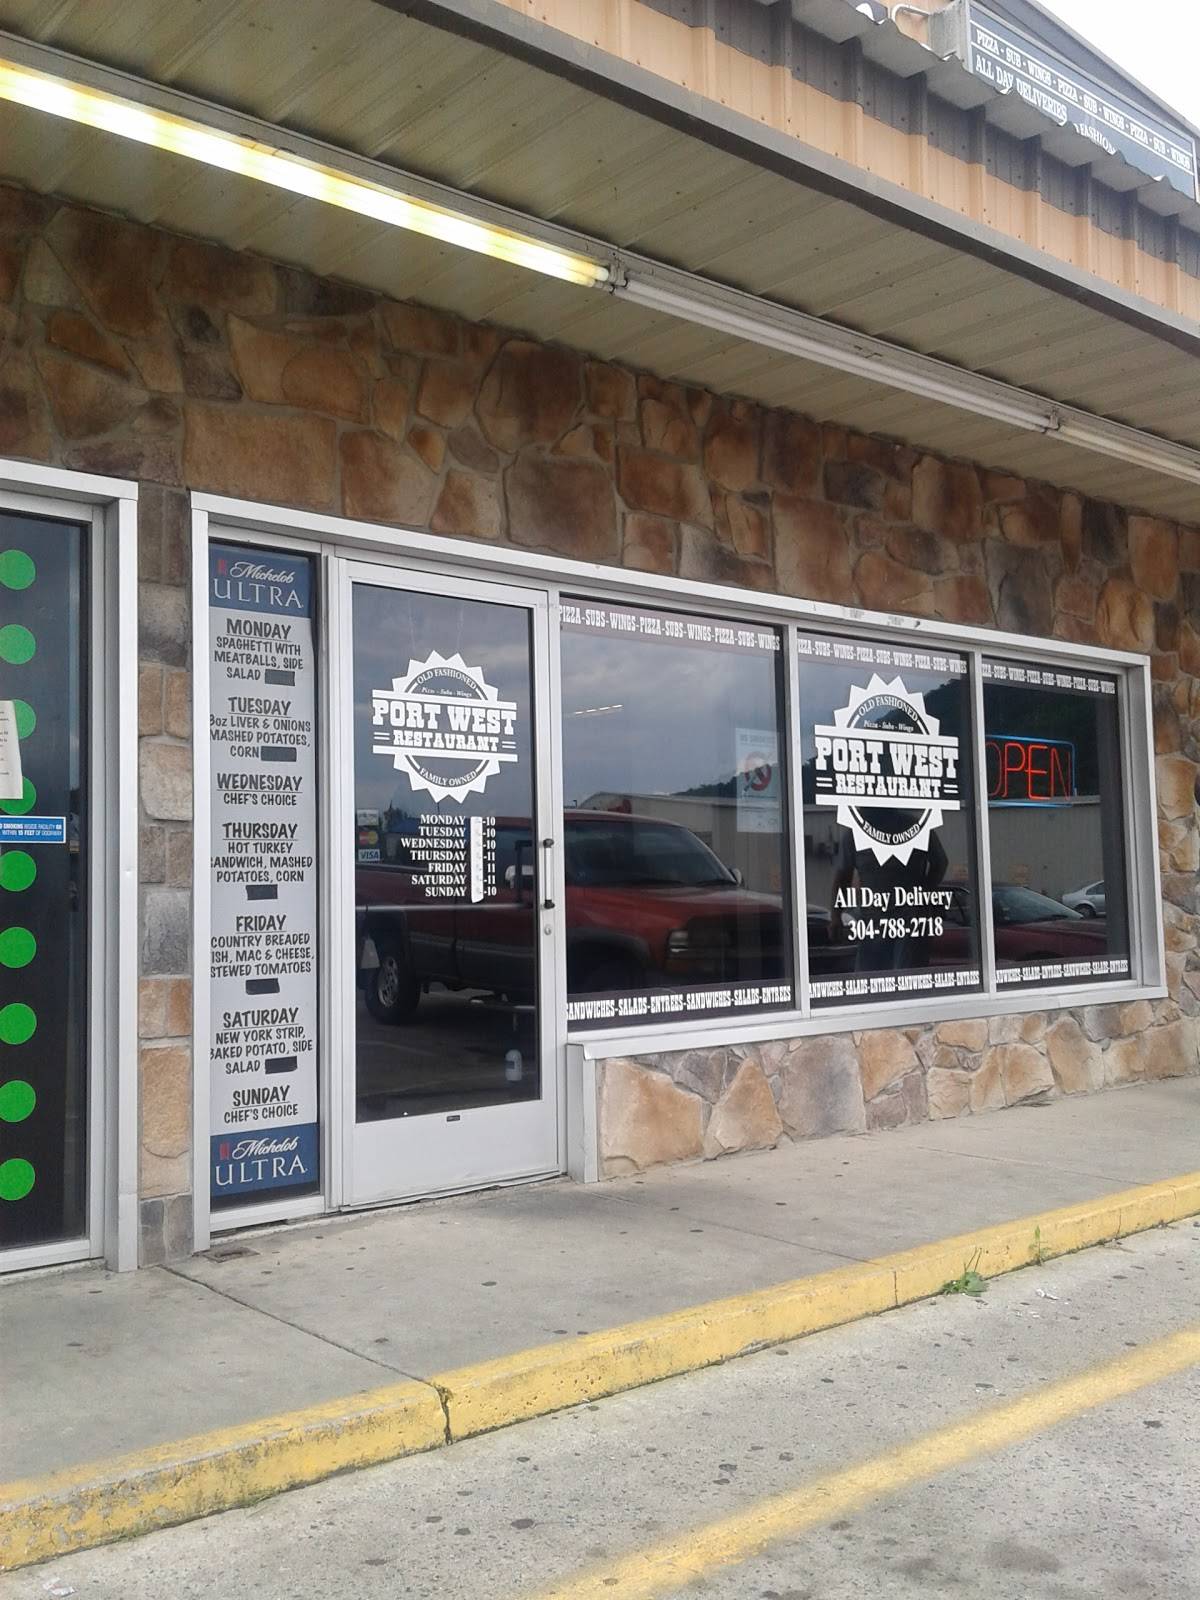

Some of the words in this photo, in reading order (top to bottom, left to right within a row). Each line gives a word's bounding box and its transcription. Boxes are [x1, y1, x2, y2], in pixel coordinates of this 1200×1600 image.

[976, 29, 999, 55] PIZZA
[1006, 47, 1021, 68] SUB
[1028, 61, 1051, 86] WINGS
[1058, 78, 1078, 102] PIZZA
[1083, 94, 1097, 114] SUB
[1103, 106, 1124, 130] WINGS
[1130, 122, 1148, 144] PIZZA
[976, 56, 994, 81] ALL
[996, 66, 1013, 91] DAY
[1016, 78, 1067, 124] DELIVERIES
[230, 561, 295, 583] Michelob
[214, 578, 303, 608] ULTRA
[226, 618, 291, 640] MONDAY
[216, 636, 272, 653] SPAGHETTI
[275, 642, 301, 656] WITH
[214, 650, 280, 669] MEATBALLS,
[283, 657, 304, 670] SIDE
[226, 667, 261, 681] SALAD
[416, 671, 434, 685] OLD
[434, 668, 477, 690] FASHIONED
[228, 697, 291, 715] TUESDAY
[858, 698, 875, 716] OLD
[875, 695, 919, 722] FASHIONED
[231, 716, 259, 729] LIVER
[263, 718, 270, 729] &
[273, 719, 311, 732] ONIONS
[372, 699, 441, 730] PORT
[447, 705, 517, 735] WEST
[210, 729, 253, 743] MASHED
[257, 732, 311, 747] POTATOES,
[393, 730, 499, 751] RESTAURANT
[230, 745, 259, 758] CORN
[815, 736, 883, 774] PORT
[889, 742, 959, 778] WEST
[217, 773, 302, 791] WEDNESDAY
[419, 769, 447, 786] FAMILY
[448, 770, 477, 787] OWNED
[835, 773, 941, 798] RESTAURANT
[223, 793, 258, 805] CHEF'S
[261, 794, 297, 806] CHOICE
[420, 814, 466, 825] MONDAY
[222, 822, 298, 839] THURSDAY
[419, 826, 466, 837] TUESDAY
[862, 820, 891, 844] FAMILY
[892, 823, 920, 844] OWNED
[228, 842, 250, 854] HOT
[253, 842, 293, 854] TURKEY
[401, 838, 466, 849] WEDNESDAY
[270, 856, 313, 868] MASHED
[360, 850, 379, 860] VISA
[410, 850, 466, 861] THURSDAY
[216, 870, 274, 883] POTATOES,
[276, 870, 304, 882] CORN
[428, 862, 467, 873] FRIDAY
[411, 874, 467, 885] SATURDAY
[425, 886, 467, 897] SUNDAY
[834, 887, 857, 908] All
[861, 887, 890, 912] Day
[894, 886, 952, 910] Delivery
[236, 915, 287, 932] FRIDAY
[848, 917, 943, 940] 304-788-2718
[211, 935, 262, 948] COUNTRY
[265, 933, 310, 946] BREADED
[236, 950, 262, 962] MAC
[265, 949, 272, 960] &
[275, 947, 315, 960] CHEESE,
[210, 964, 252, 978] STEWED
[255, 961, 311, 976] TOMATOES
[223, 1007, 299, 1028] SATURDAY
[216, 1031, 240, 1045] NEW
[243, 1029, 273, 1042] YORK
[275, 1026, 306, 1040] STRIP,
[246, 1043, 289, 1057] POTATO,
[292, 1040, 313, 1053] SIDE
[225, 1060, 261, 1075] SALAD
[233, 1085, 290, 1107] SUNDAY
[224, 1108, 259, 1124] CHEF'S
[261, 1103, 298, 1119] CHOICE
[232, 1136, 300, 1159] Michelob
[216, 1154, 306, 1186] ULTRA
